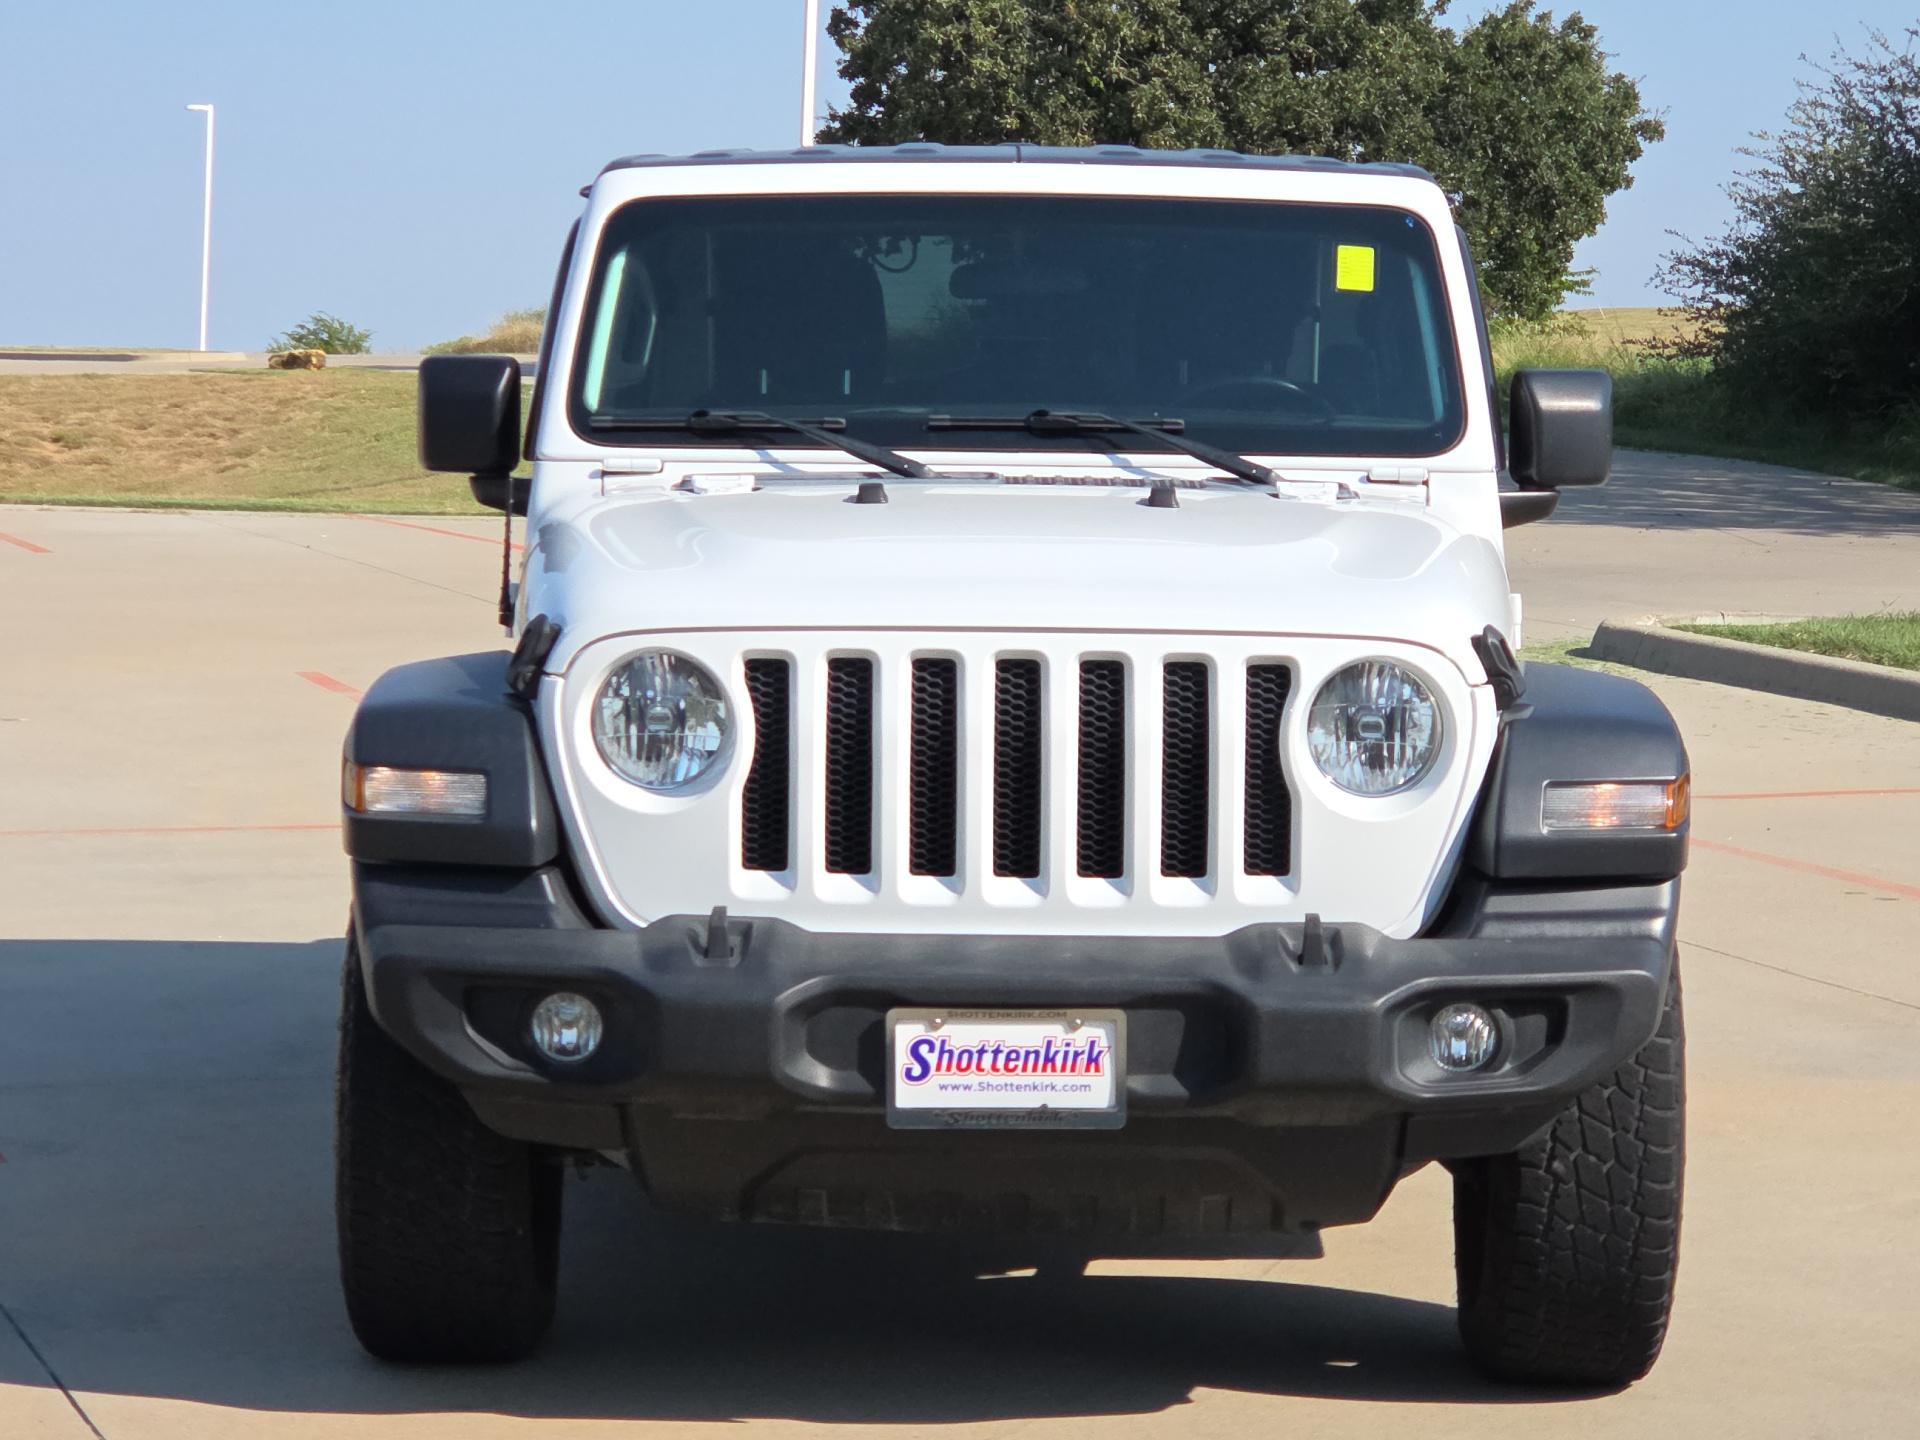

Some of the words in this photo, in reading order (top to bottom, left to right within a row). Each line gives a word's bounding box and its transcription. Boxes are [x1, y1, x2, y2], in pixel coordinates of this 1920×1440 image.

[947, 1010, 1068, 1019] SHOTTENKIRK.COM
[903, 1037, 1107, 1083] Shottenkirk
[938, 1081, 1092, 1093] www.Shottenkirk.com
